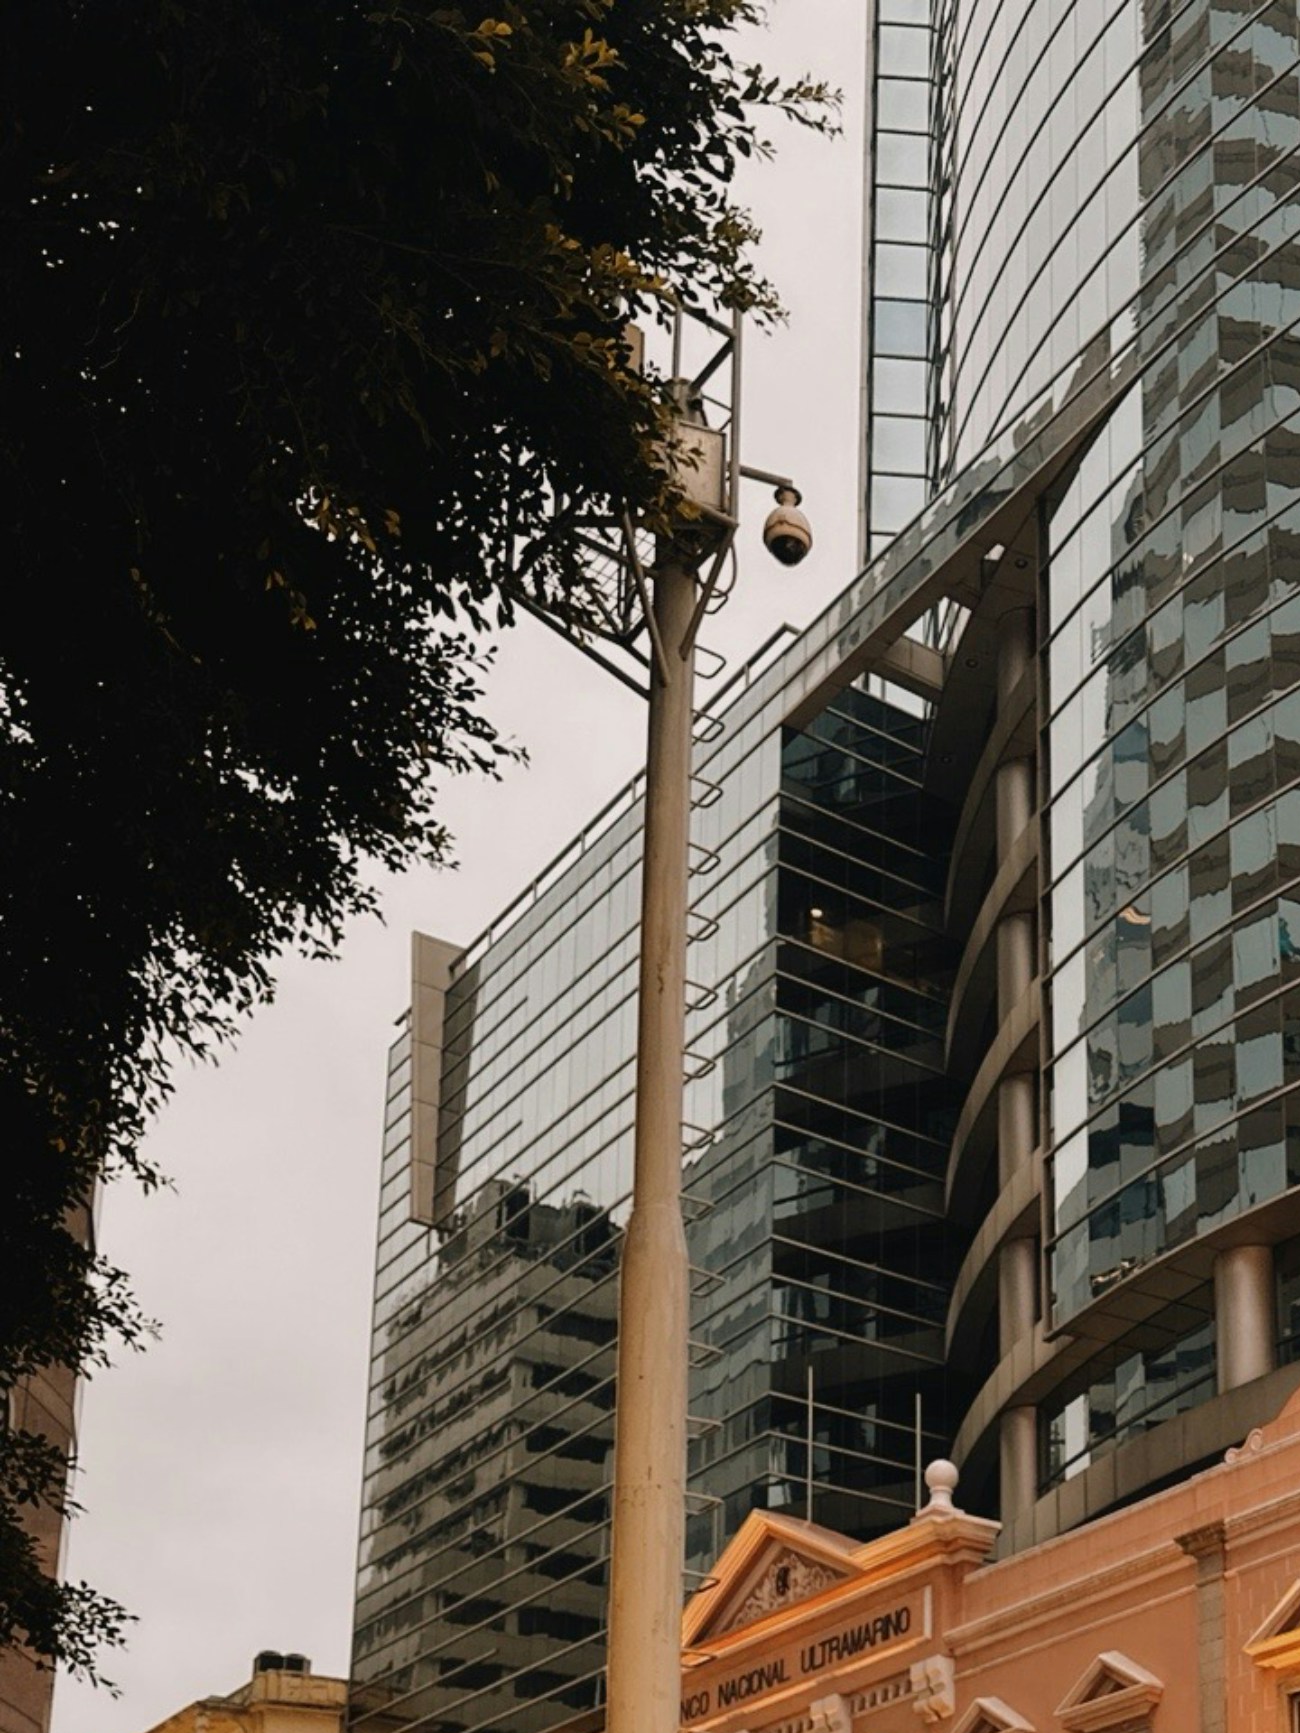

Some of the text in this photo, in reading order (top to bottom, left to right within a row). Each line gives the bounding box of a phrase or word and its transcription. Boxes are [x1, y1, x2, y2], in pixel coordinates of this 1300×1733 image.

[680, 1606, 911, 1723] NCO NACIONAL ULTRAMARINO
